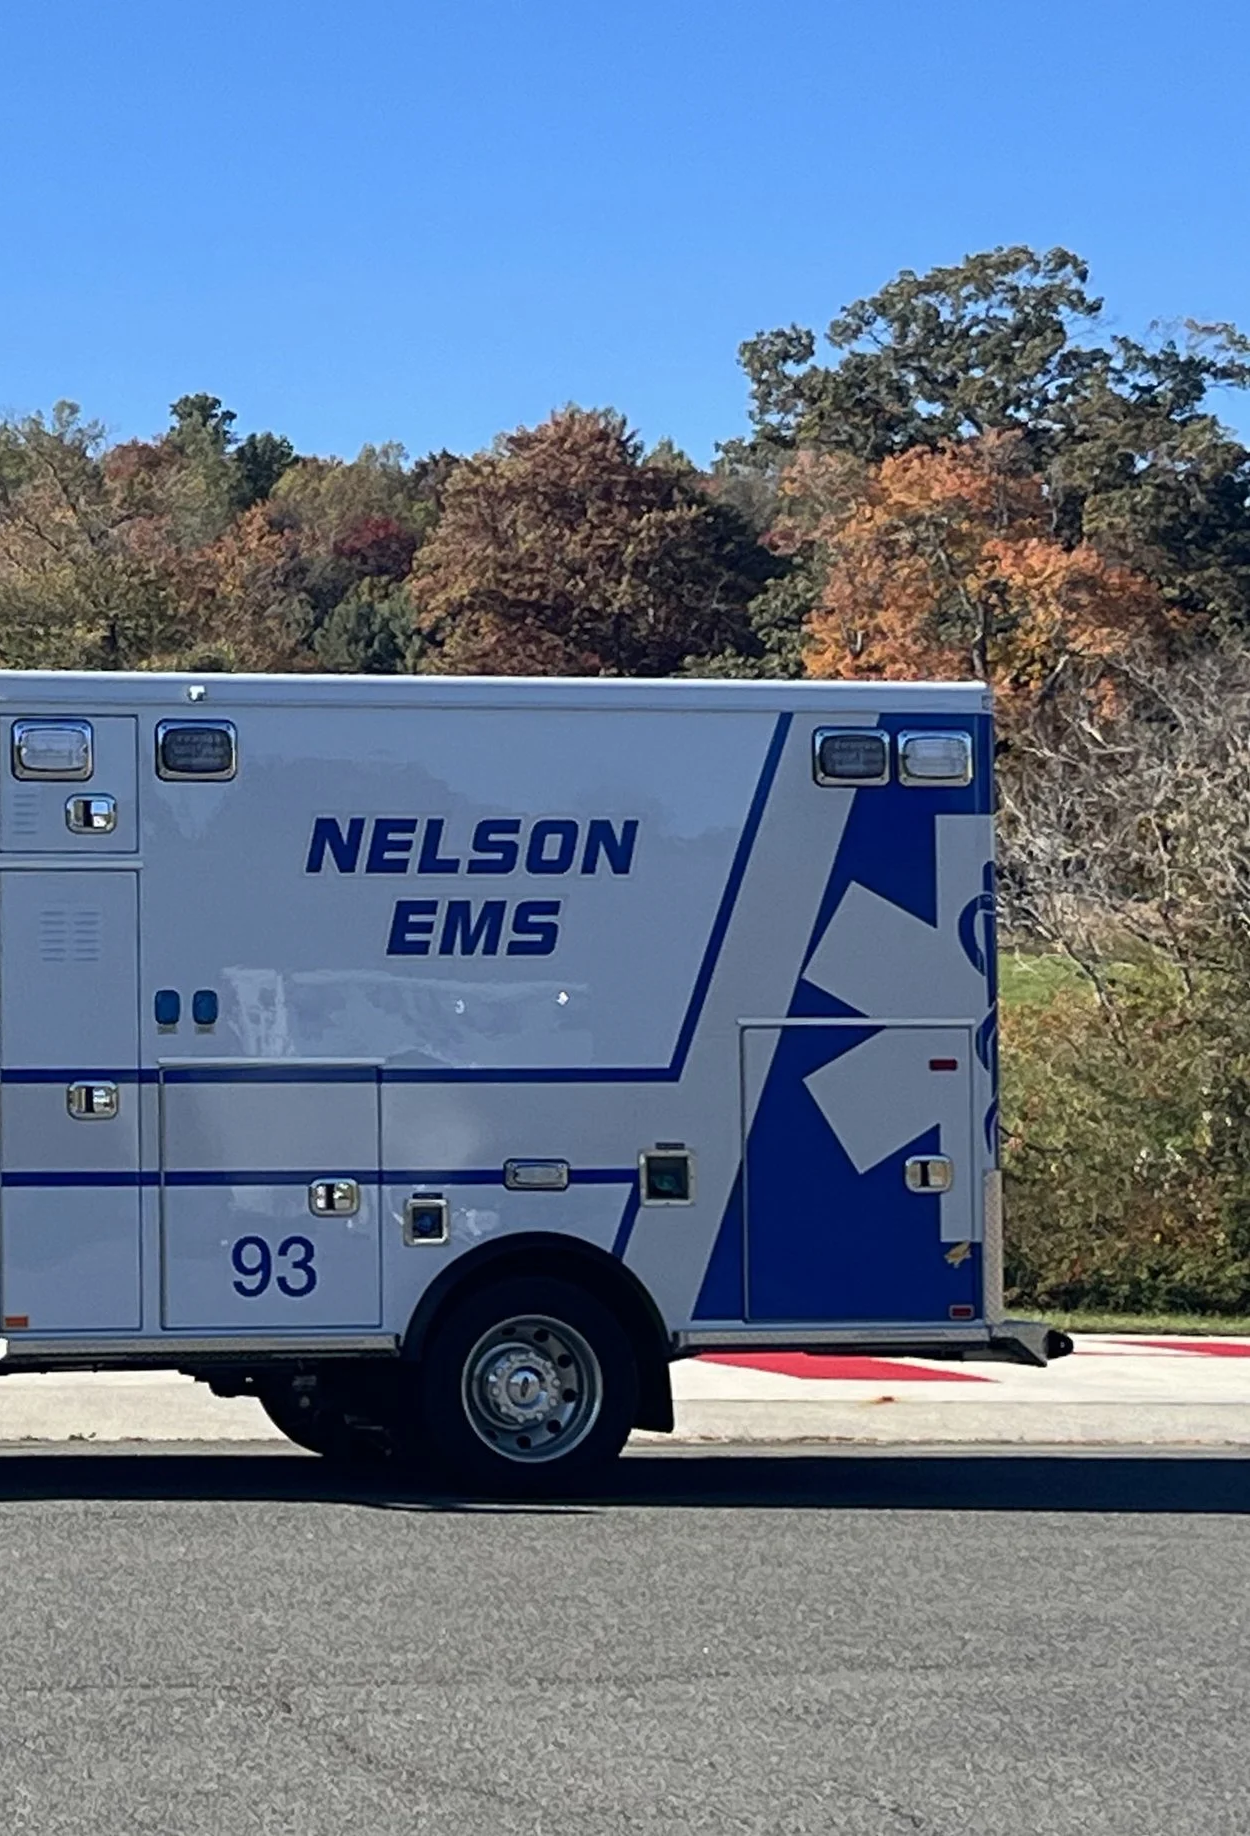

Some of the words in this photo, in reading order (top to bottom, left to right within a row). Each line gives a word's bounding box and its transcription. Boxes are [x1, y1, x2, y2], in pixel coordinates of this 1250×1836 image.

[305, 817, 639, 875] NELSON
[386, 899, 562, 956] EMS
[231, 1235, 318, 1298] 93
